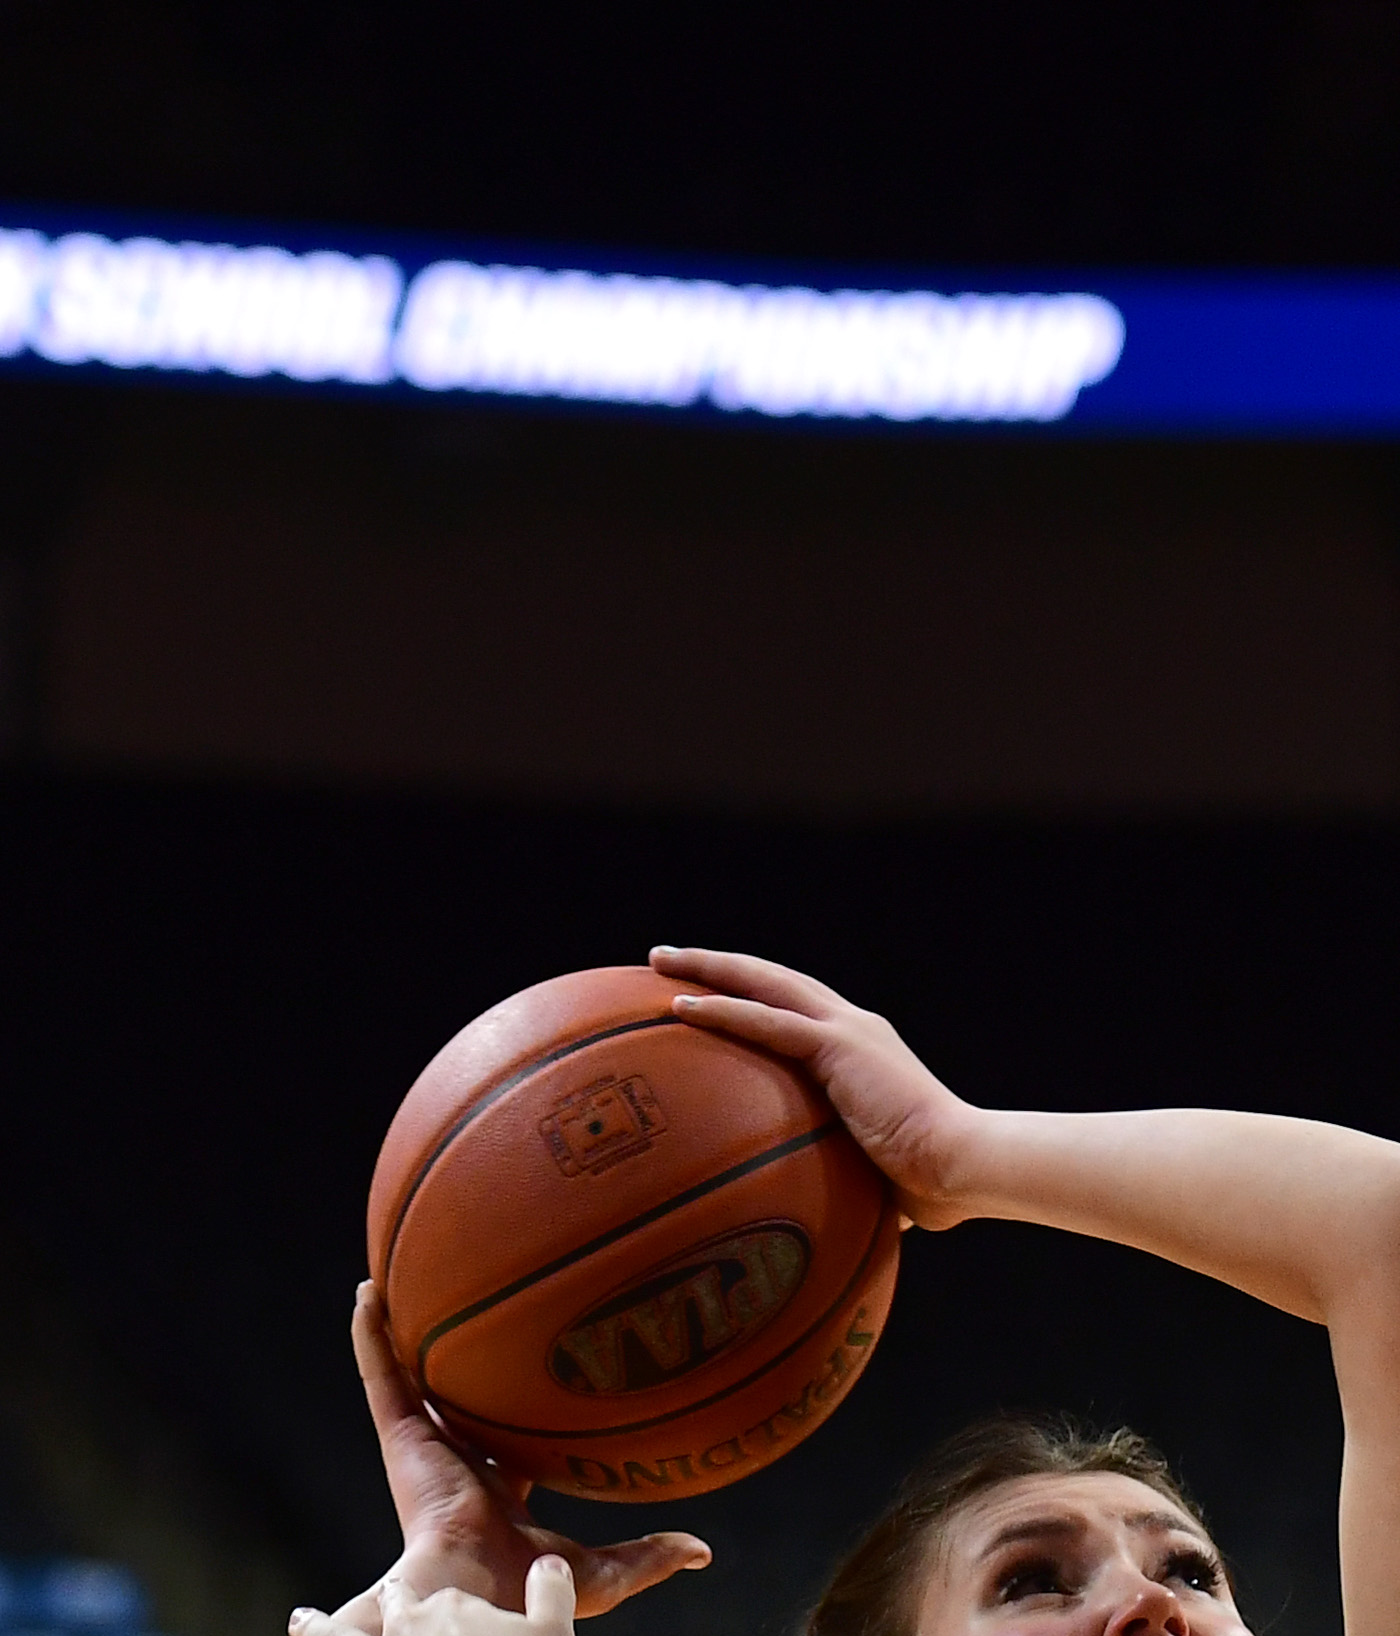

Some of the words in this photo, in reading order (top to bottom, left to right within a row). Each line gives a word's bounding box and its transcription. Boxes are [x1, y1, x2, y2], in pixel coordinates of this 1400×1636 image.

[398, 260, 1126, 421] CHAMPIONSHIP
[556, 1238, 790, 1394] PIAA
[566, 1306, 875, 1490] SPALDING
